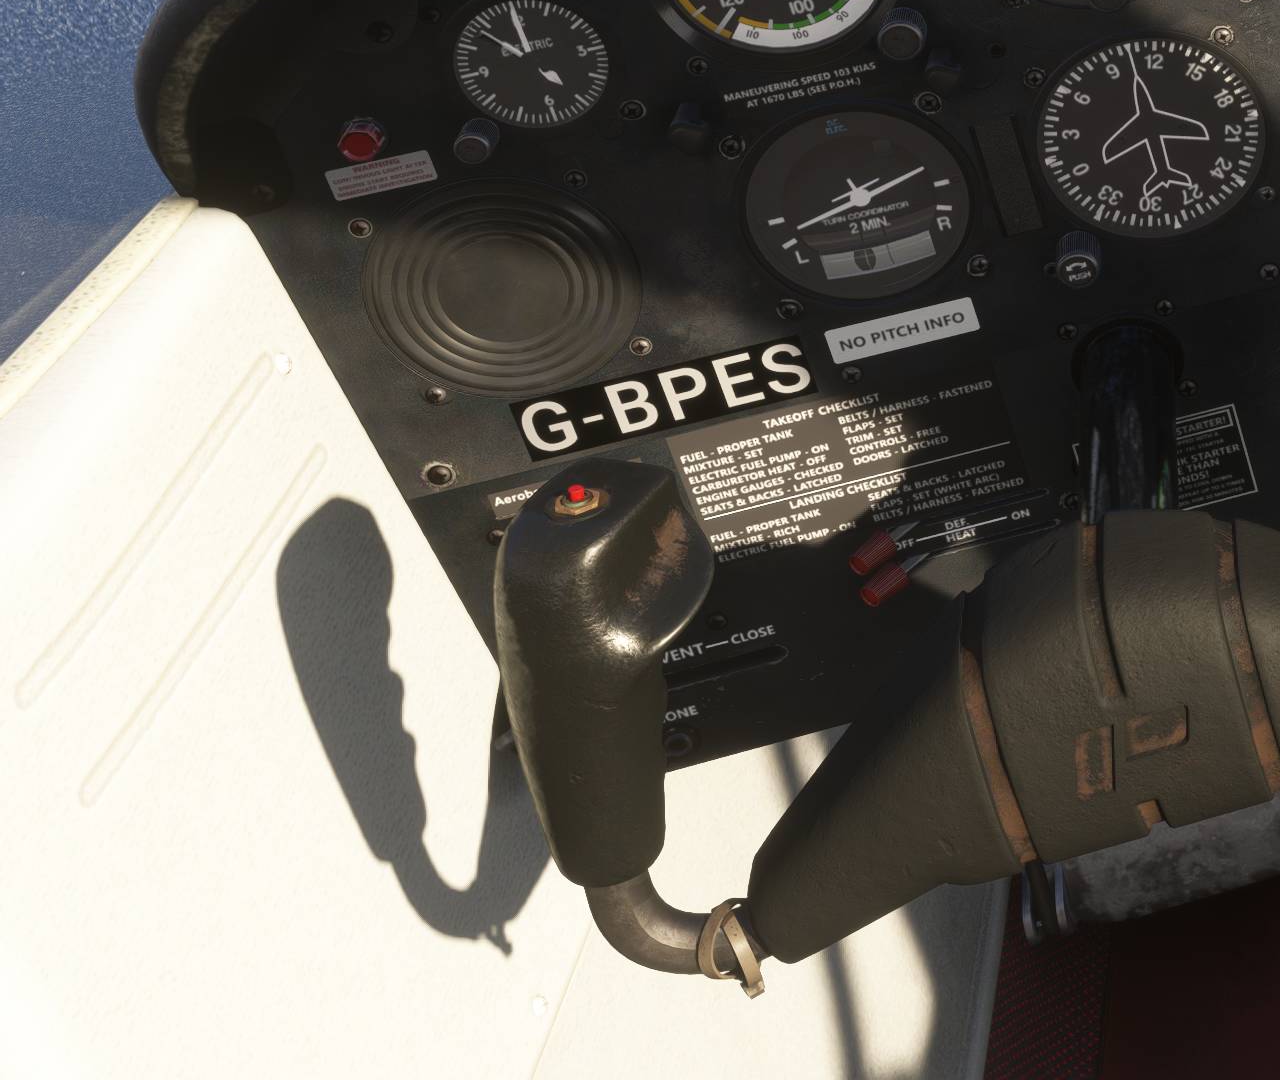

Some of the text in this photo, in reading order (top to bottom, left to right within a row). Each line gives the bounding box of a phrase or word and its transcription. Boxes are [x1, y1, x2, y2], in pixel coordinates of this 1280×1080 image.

[723, 62, 876, 102] MANEUVERING SPEED 103 KIAS
[747, 98, 759, 108] AT
[762, 93, 785, 105] 1670
[787, 88, 805, 100] LBS
[807, 83, 827, 96] (SEE
[839, 311, 966, 352] NO PITCH INFO
[521, 343, 812, 452] G-BPES
[762, 392, 880, 429] TAKEOFF CHECKLIST
[837, 380, 993, 424] BELTS HARNESS FASTENED
[842, 413, 904, 435] FLAPS SET
[845, 425, 903, 446] TRIM SET
[849, 426, 942, 455] CONTROLS FREE
[680, 429, 794, 464] FUEL PROPER TANK
[684, 448, 764, 475] MIXTURE SET
[688, 443, 830, 485] ELECTRIC FUEL PUMP ON
[853, 435, 949, 466] DOORS LATCHED
[692, 455, 827, 495] CARBURETOR HEAT OFF
[696, 462, 844, 505] ENGINE GAUGES CHECKED
[789, 472, 908, 509] LANDING CHECKLIST
[700, 474, 842, 516] SEATS & BACKS LATCHED
[1011, 508, 1031, 520] ON
[730, 624, 776, 646] CLOSE
